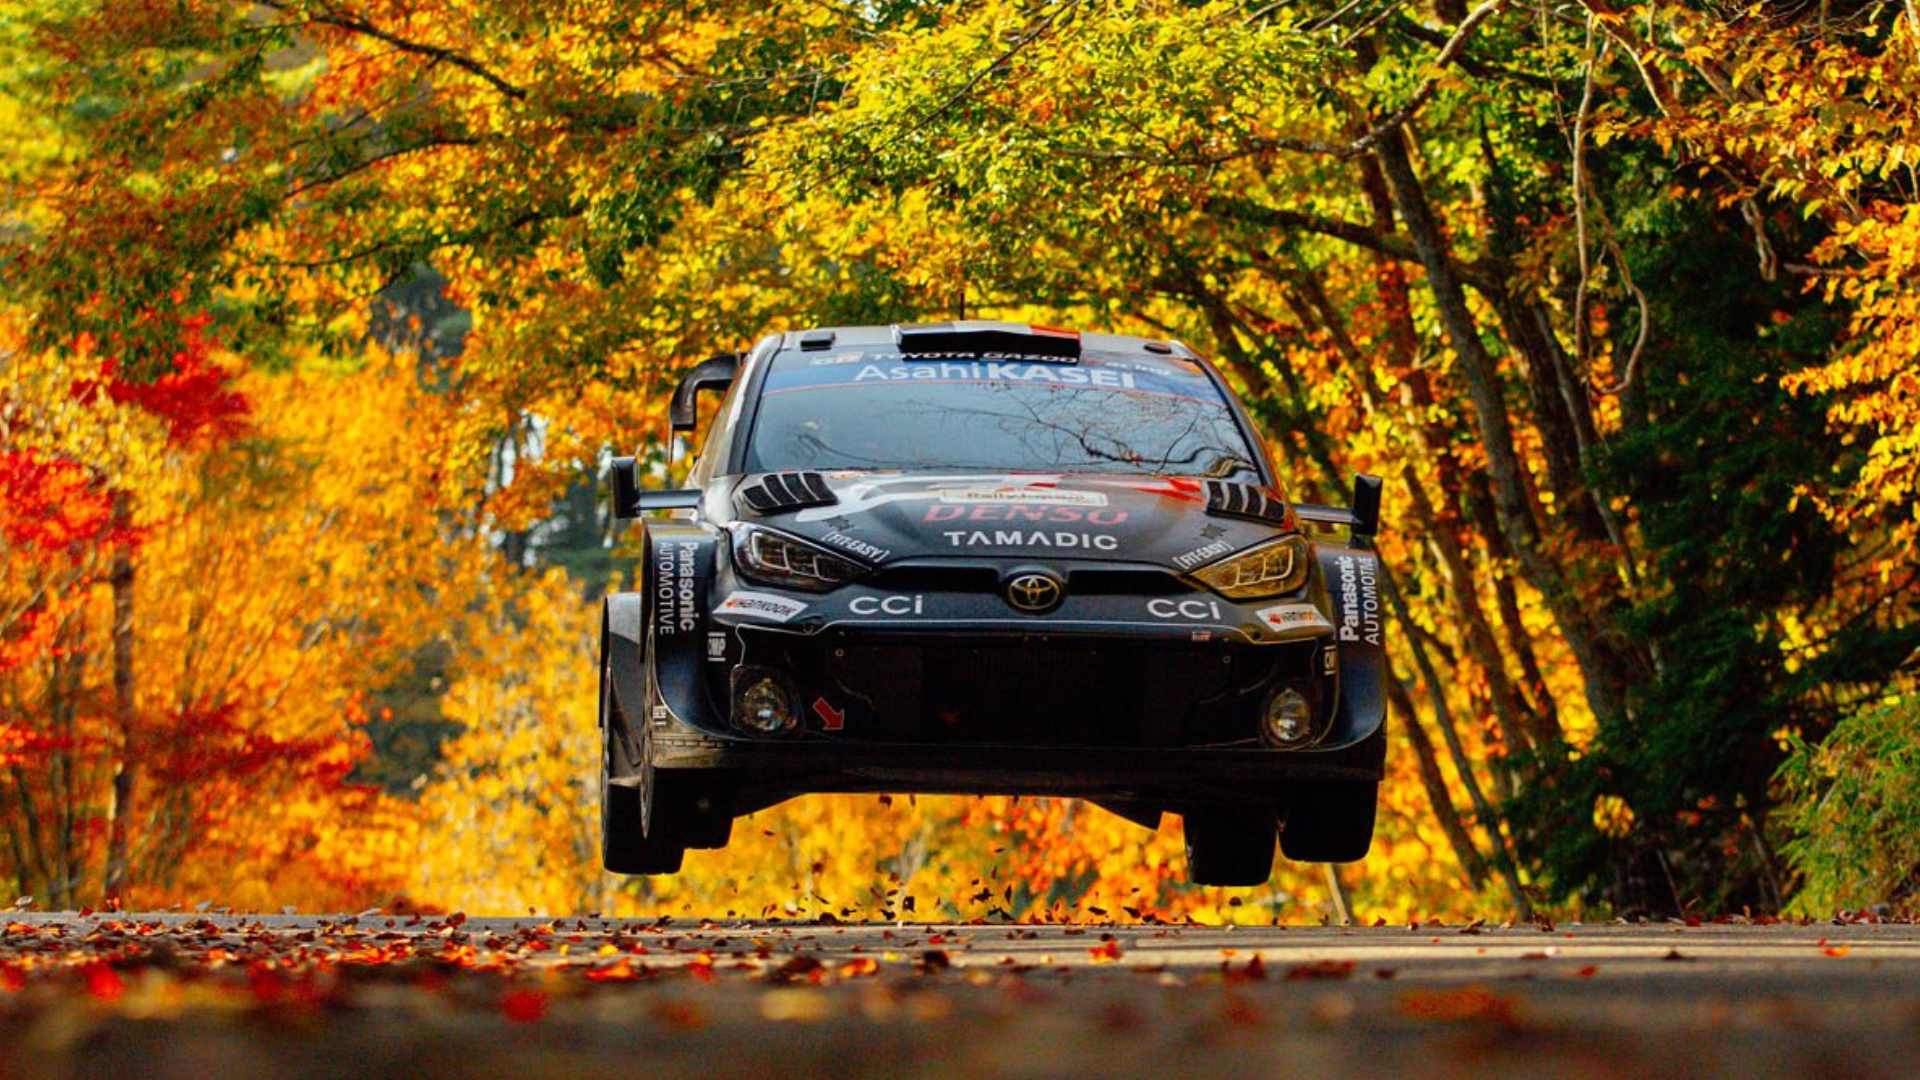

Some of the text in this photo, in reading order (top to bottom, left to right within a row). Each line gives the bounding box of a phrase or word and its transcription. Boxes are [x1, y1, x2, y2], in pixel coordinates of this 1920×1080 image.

[869, 351, 976, 359] TOYOTA
[982, 351, 1079, 363] GAZOO
[922, 504, 1129, 525] DENSO
[943, 530, 1119, 550] TAMADIC
[659, 541, 675, 635] AUTOMOTIVE
[679, 541, 699, 632] Panasonic
[1335, 554, 1360, 642] Panasonic
[1357, 556, 1380, 646] AUTOMOTIVE
